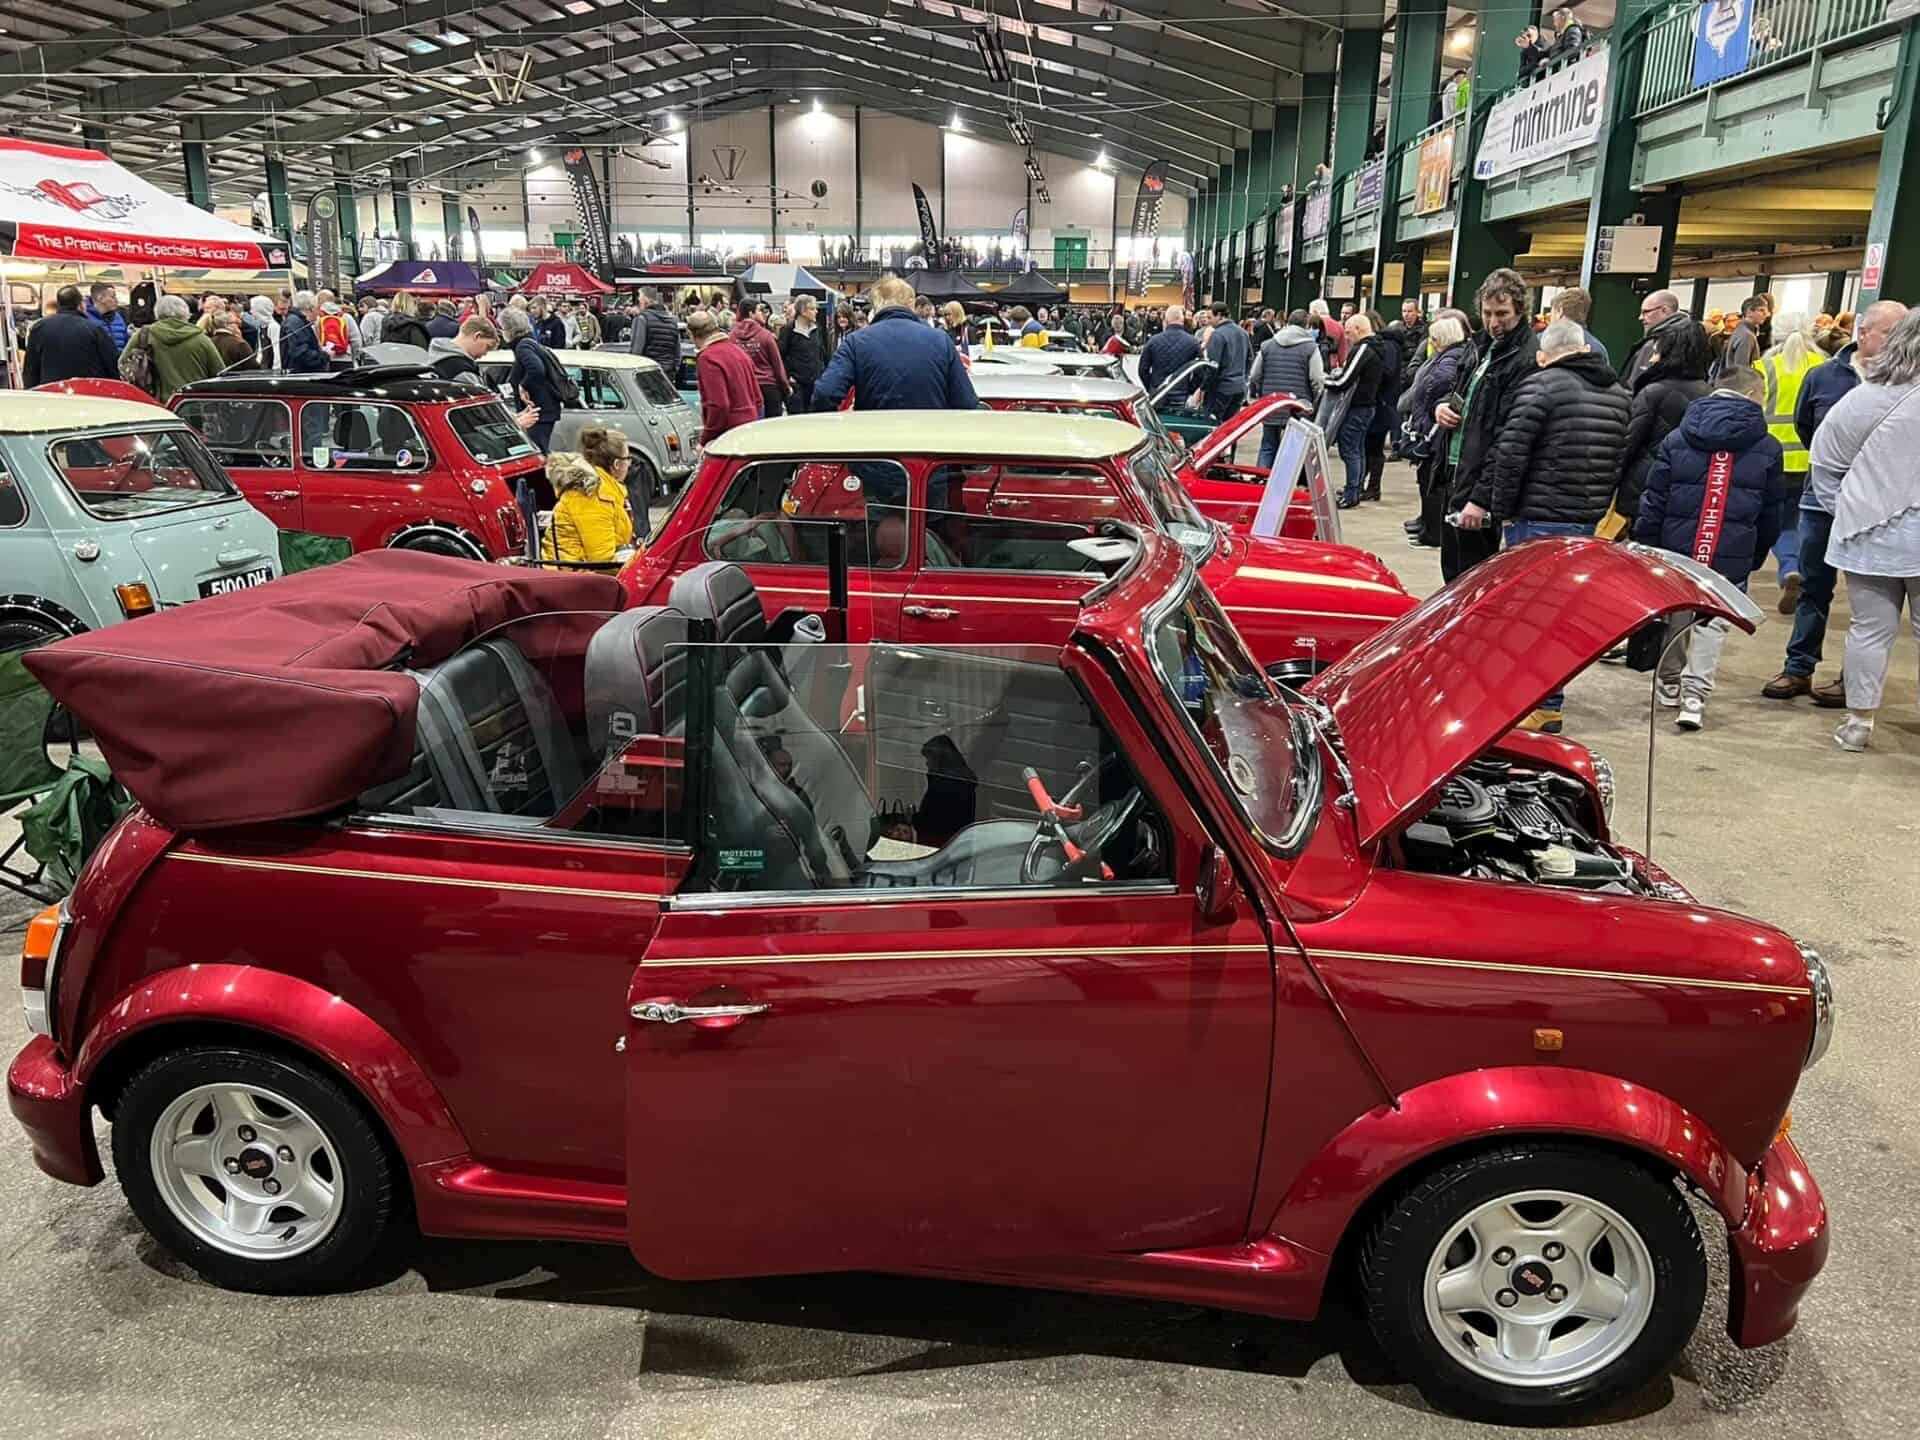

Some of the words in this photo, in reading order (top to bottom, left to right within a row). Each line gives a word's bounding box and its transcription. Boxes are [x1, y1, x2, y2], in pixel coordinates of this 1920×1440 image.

[1509, 71, 1599, 153] minimine
[34, 233, 63, 249] The
[64, 236, 116, 252] Premier
[118, 241, 144, 254] Mini
[144, 242, 198, 257] Specialist
[199, 247, 228, 259] Since
[313, 220, 323, 257] EVENTS
[1709, 450, 1729, 495] OMMY
